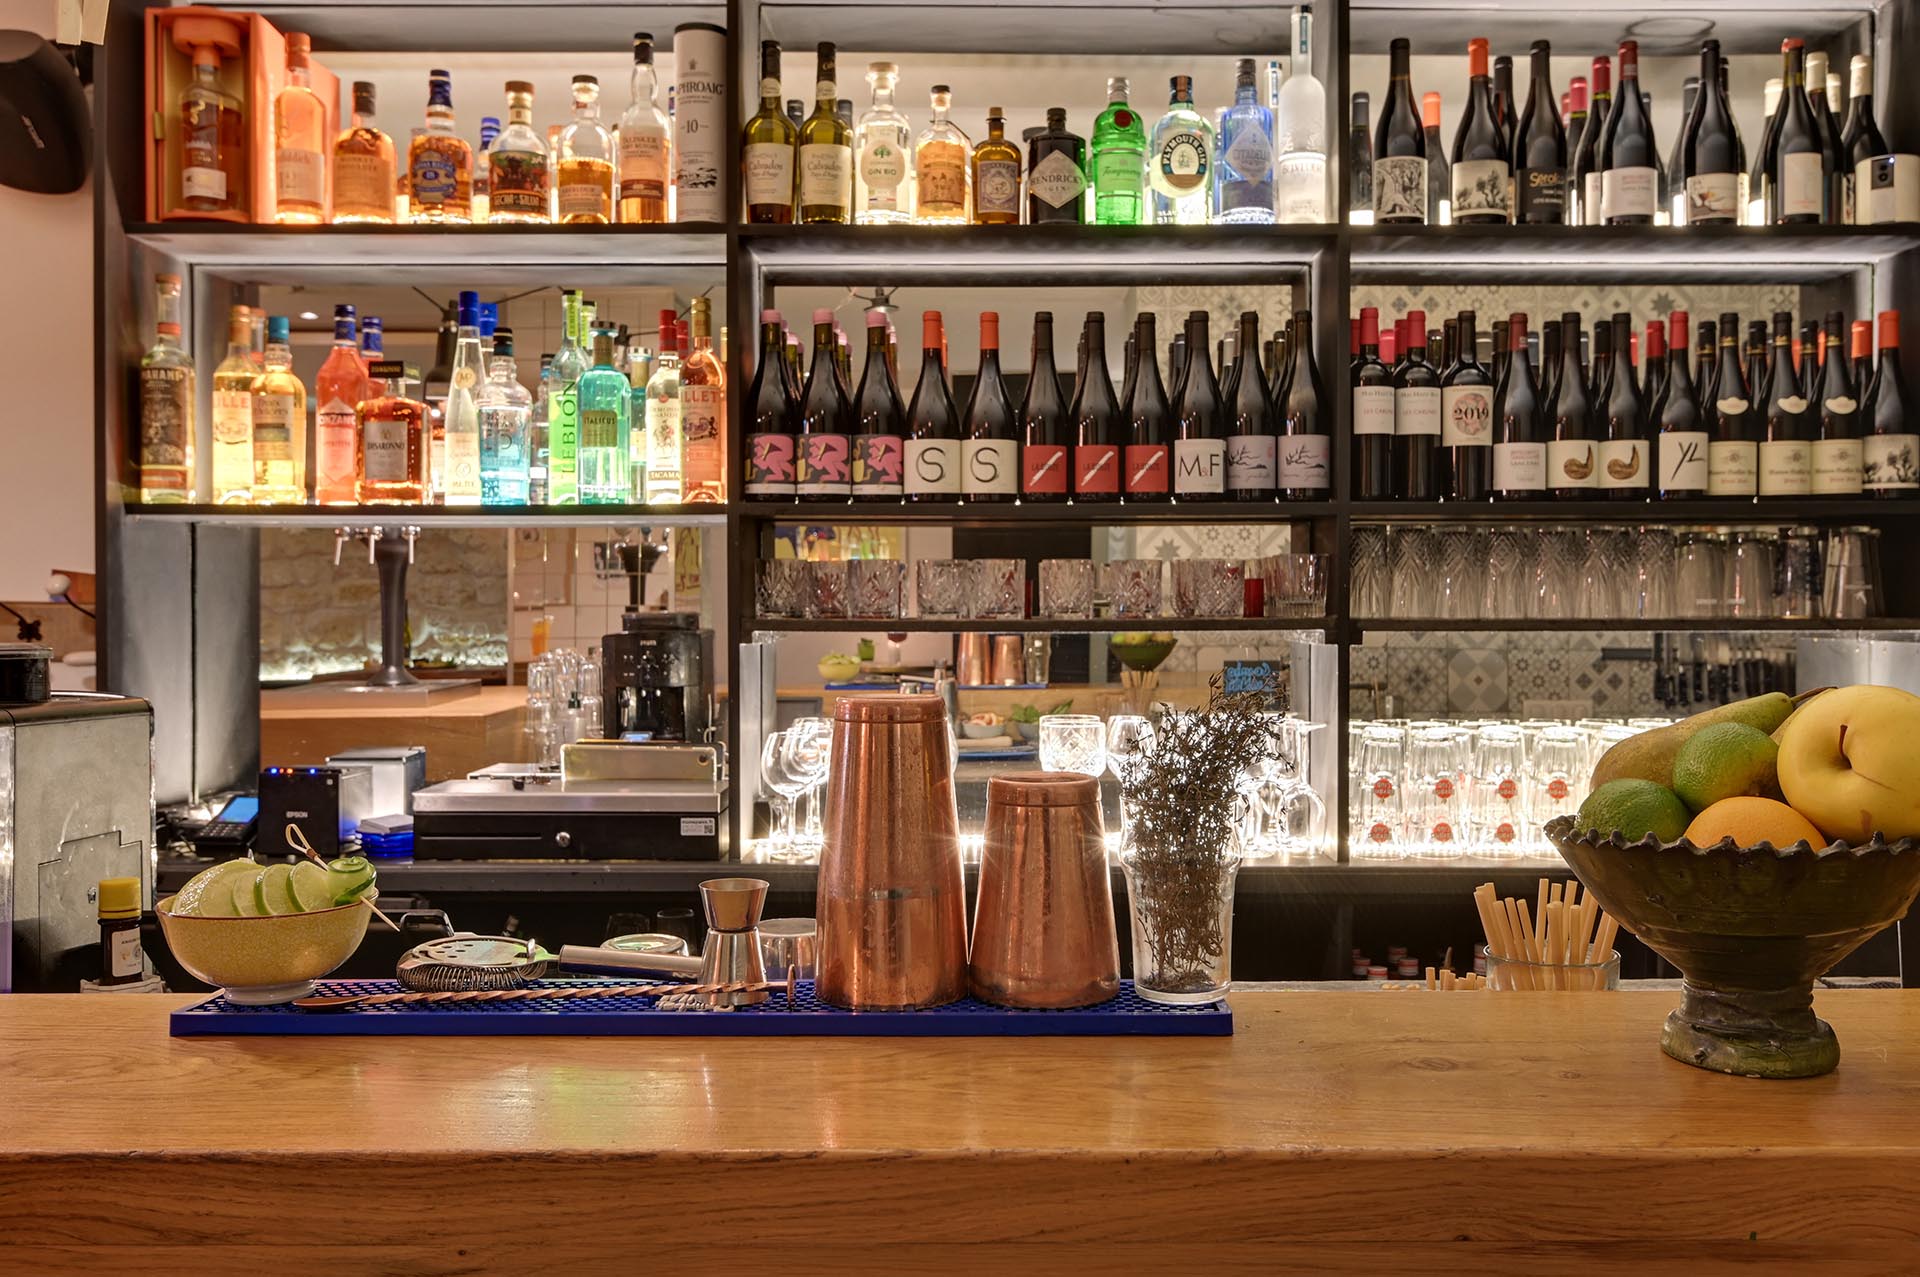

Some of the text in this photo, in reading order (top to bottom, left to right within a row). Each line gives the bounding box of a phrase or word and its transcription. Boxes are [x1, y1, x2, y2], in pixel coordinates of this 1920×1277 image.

[678, 82, 724, 95] PHROAIG
[1162, 133, 1199, 165] PLYMOUTH
[561, 380, 577, 473] LEBLON
[585, 416, 616, 425] ITALICUS
[1453, 407, 1489, 420] 2019
[915, 446, 946, 483] S
[970, 447, 1000, 483] S
